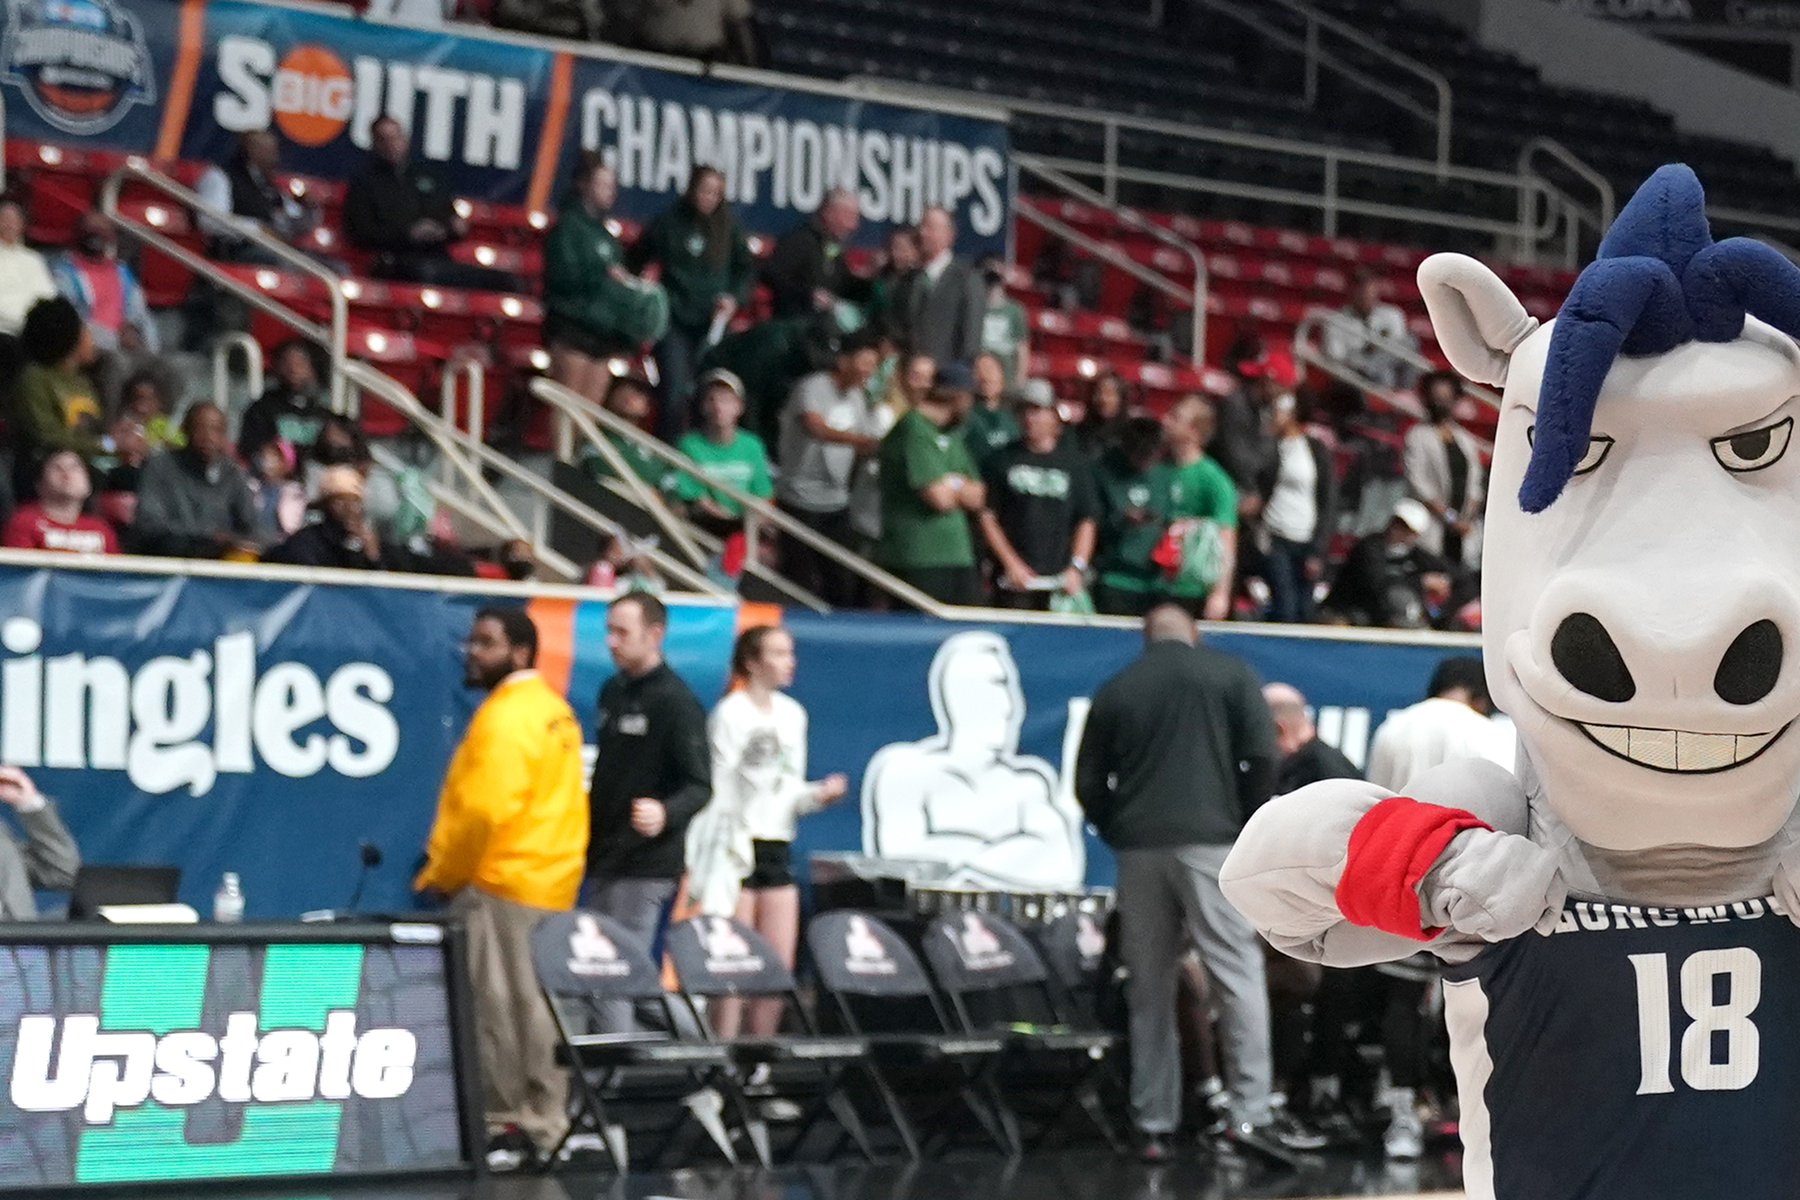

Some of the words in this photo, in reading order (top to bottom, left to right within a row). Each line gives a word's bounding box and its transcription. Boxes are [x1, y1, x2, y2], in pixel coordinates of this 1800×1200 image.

[274, 70, 353, 122] BIG
[580, 88, 1003, 237] CHAMPIONSHIPS
[1, 616, 400, 798] ingles
[10, 1009, 418, 1126] Upstate
[1627, 946, 1763, 1096] 18
